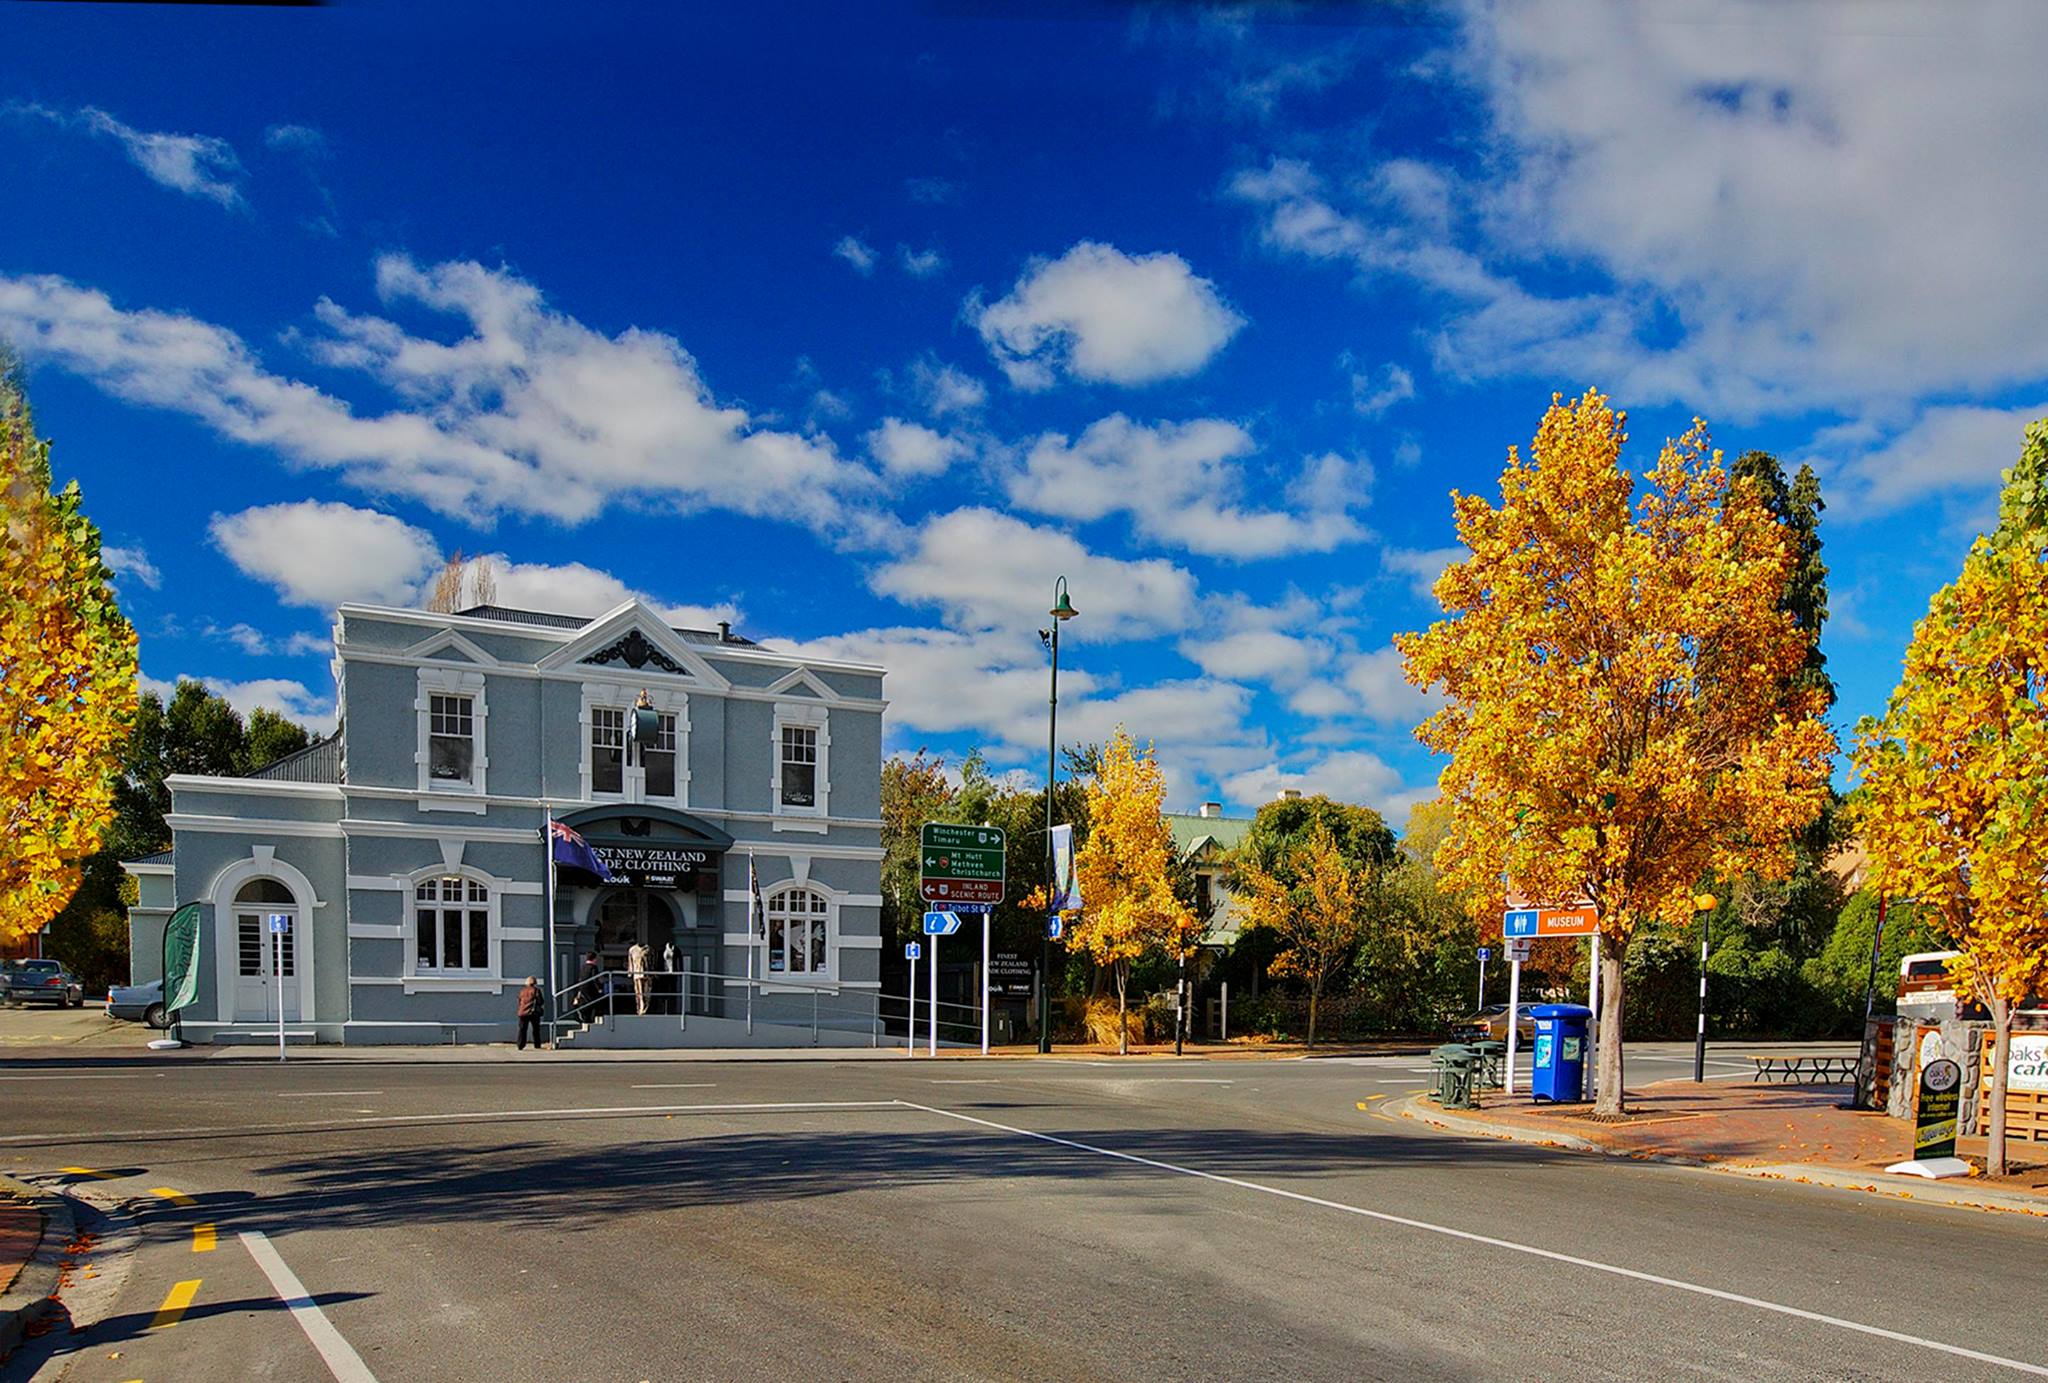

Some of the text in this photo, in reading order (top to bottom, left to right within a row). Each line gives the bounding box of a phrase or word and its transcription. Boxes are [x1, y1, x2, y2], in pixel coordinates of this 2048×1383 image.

[933, 827, 975, 836] Winchester
[933, 835, 961, 844] Timaru
[591, 847, 706, 863] EST NEW ZEALAND
[625, 860, 691, 872] CLOTHING
[951, 860, 984, 868] Methven
[951, 868, 1000, 877] Christchurch
[962, 882, 988, 890] INLAND
[951, 890, 1000, 899] SCENIC ROUTE
[948, 904, 969, 913] Talbot
[971, 905, 979, 913] St
[1547, 915, 1584, 928] MUSEUM
